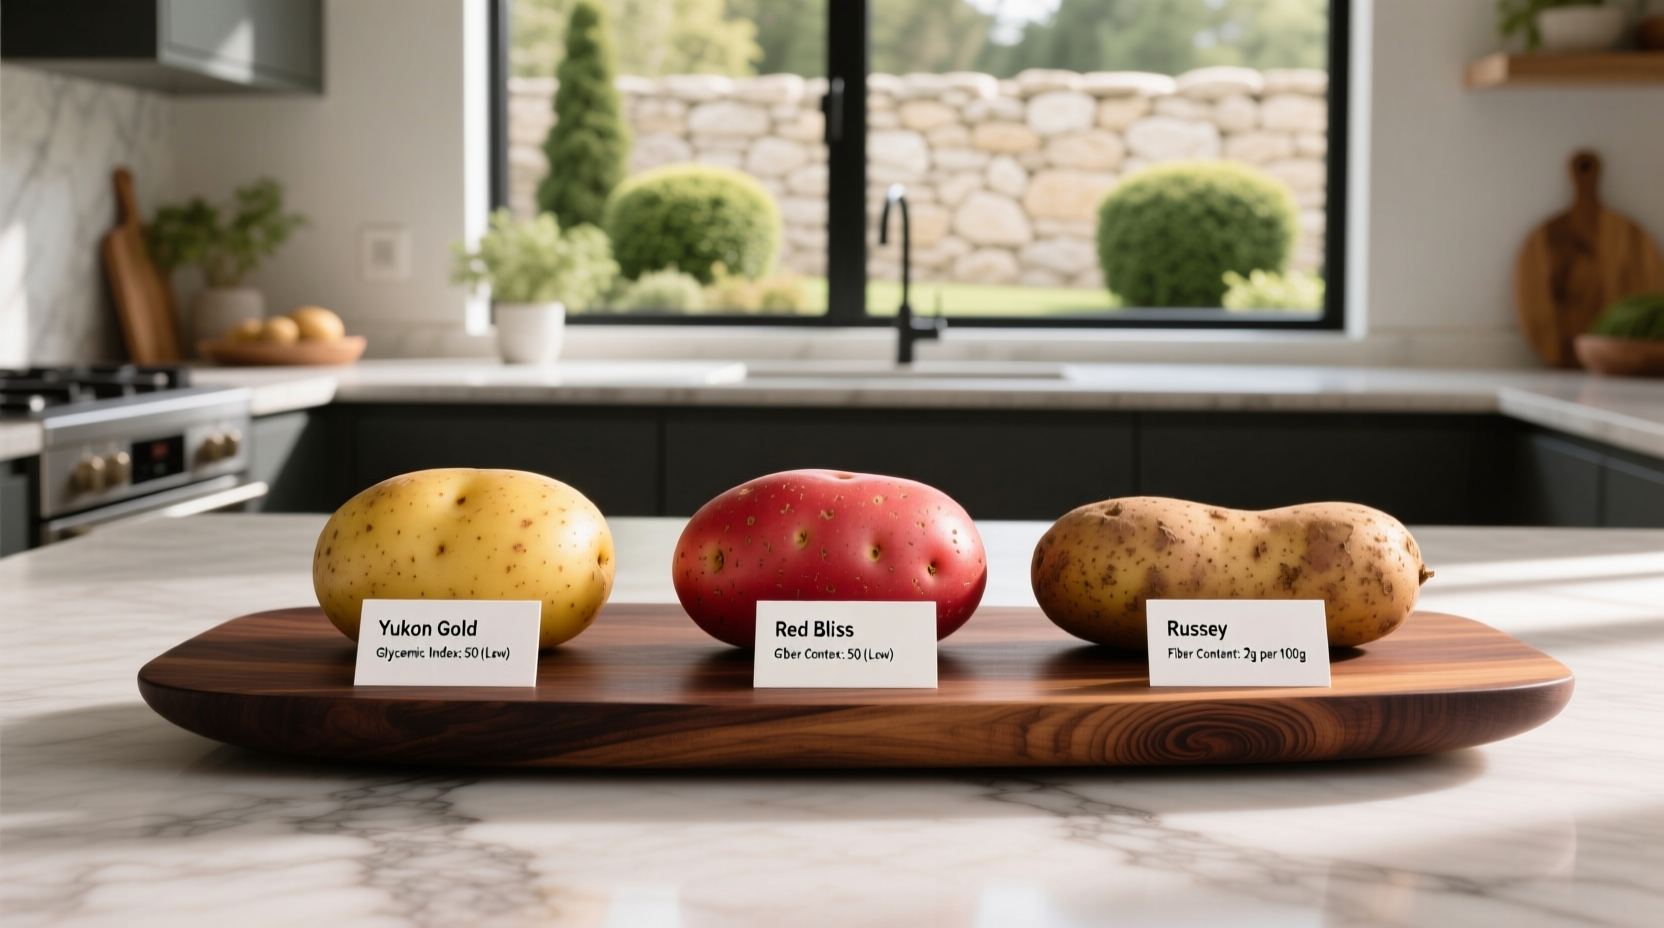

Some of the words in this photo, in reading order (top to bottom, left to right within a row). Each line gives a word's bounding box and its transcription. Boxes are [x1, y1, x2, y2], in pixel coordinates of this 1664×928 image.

[378, 619, 433, 637] Yukon
[437, 619, 478, 637] Gold
[775, 620, 808, 638] Red
[813, 619, 855, 638] Bliss
[1167, 620, 1228, 641] Russey
[429, 645, 462, 659] Index:
[464, 647, 479, 659] 50
[847, 648, 862, 661] 50
[1243, 647, 1257, 663] 2g
[1259, 650, 1279, 663] per
[1279, 648, 1307, 664] 100g
